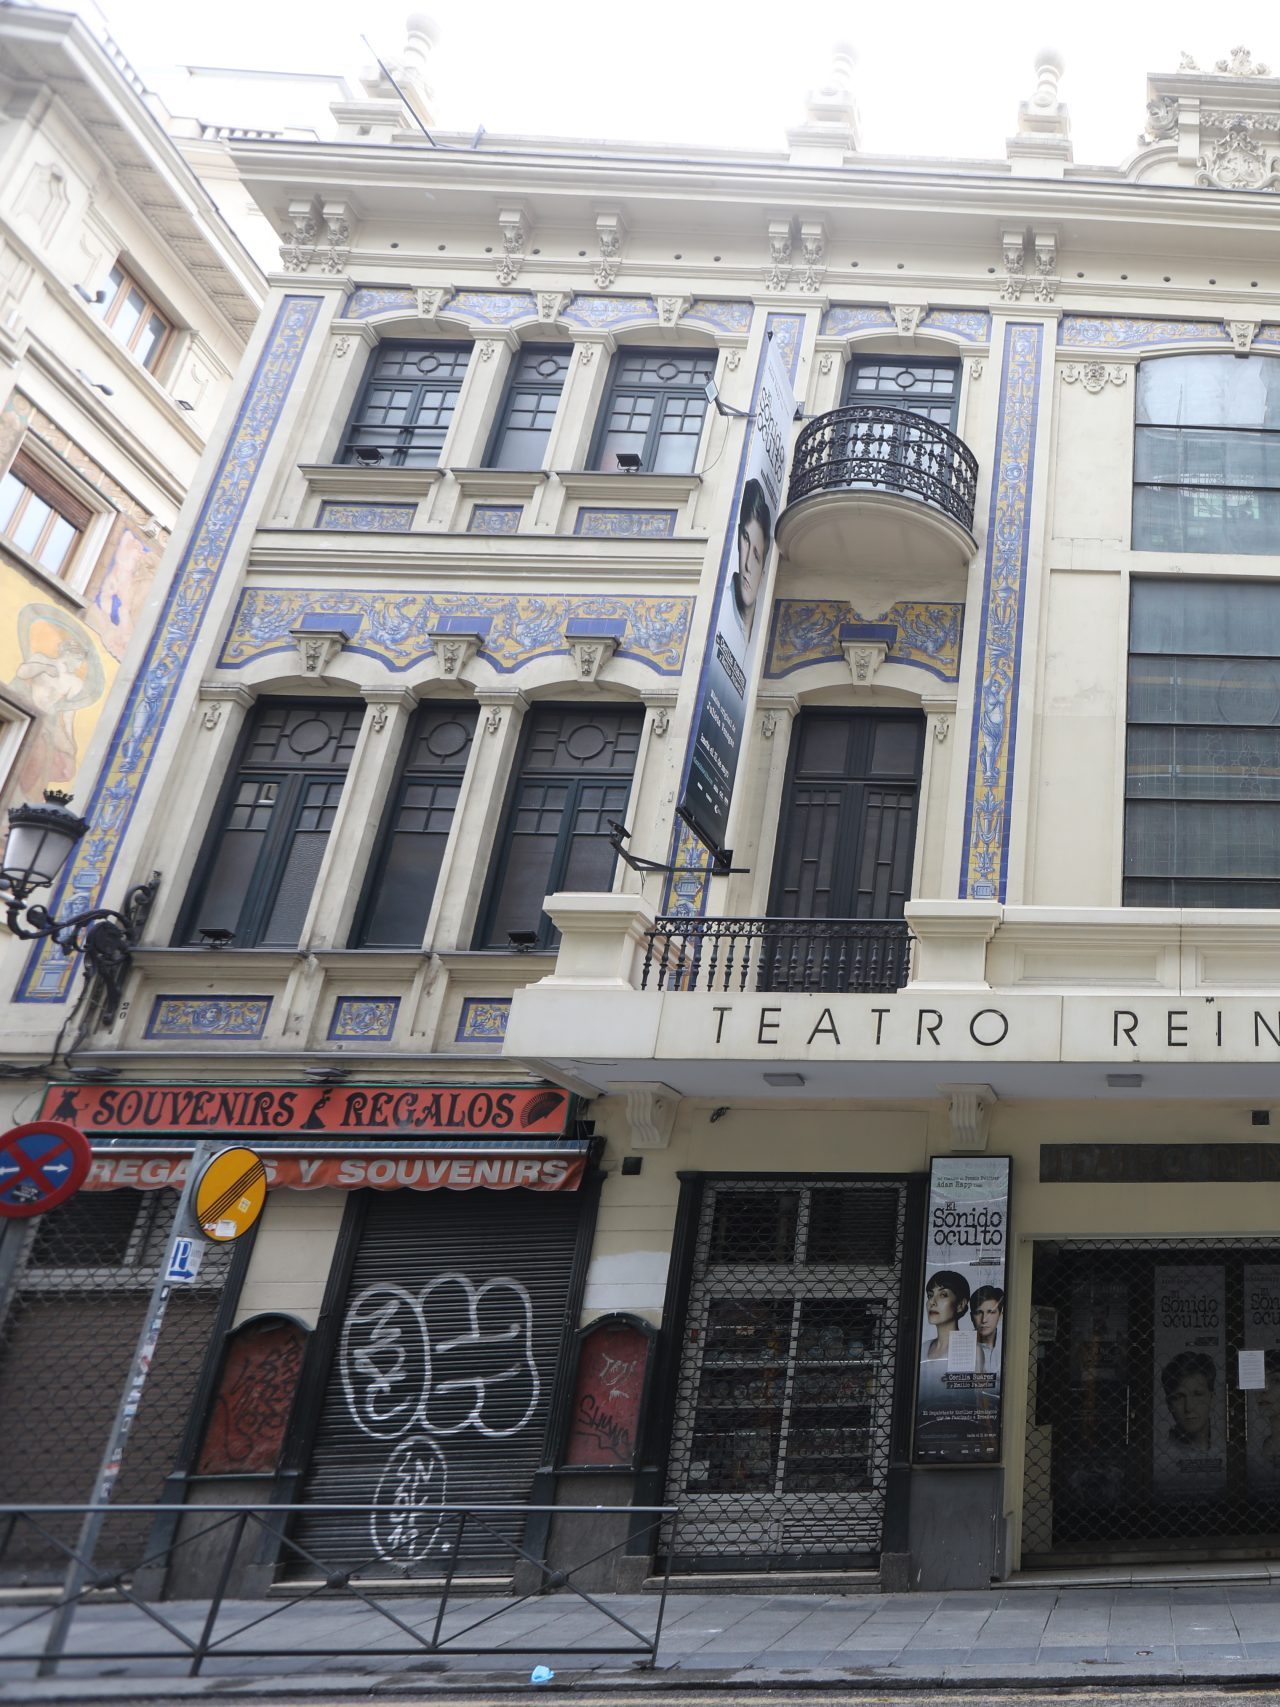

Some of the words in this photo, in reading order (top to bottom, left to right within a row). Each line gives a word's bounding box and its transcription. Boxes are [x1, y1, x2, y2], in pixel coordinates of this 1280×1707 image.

[712, 1007, 1009, 1046] TEATRO
[92, 1089, 297, 1127] SOUVENIRS
[340, 1091, 516, 1129] REGALOS
[299, 1159, 324, 1184] Y
[336, 1159, 569, 1185] SOUVENIRS
[933, 1207, 1003, 1228] Sonido
[945, 1201, 957, 1211] El
[934, 1226, 1003, 1246] oculto
